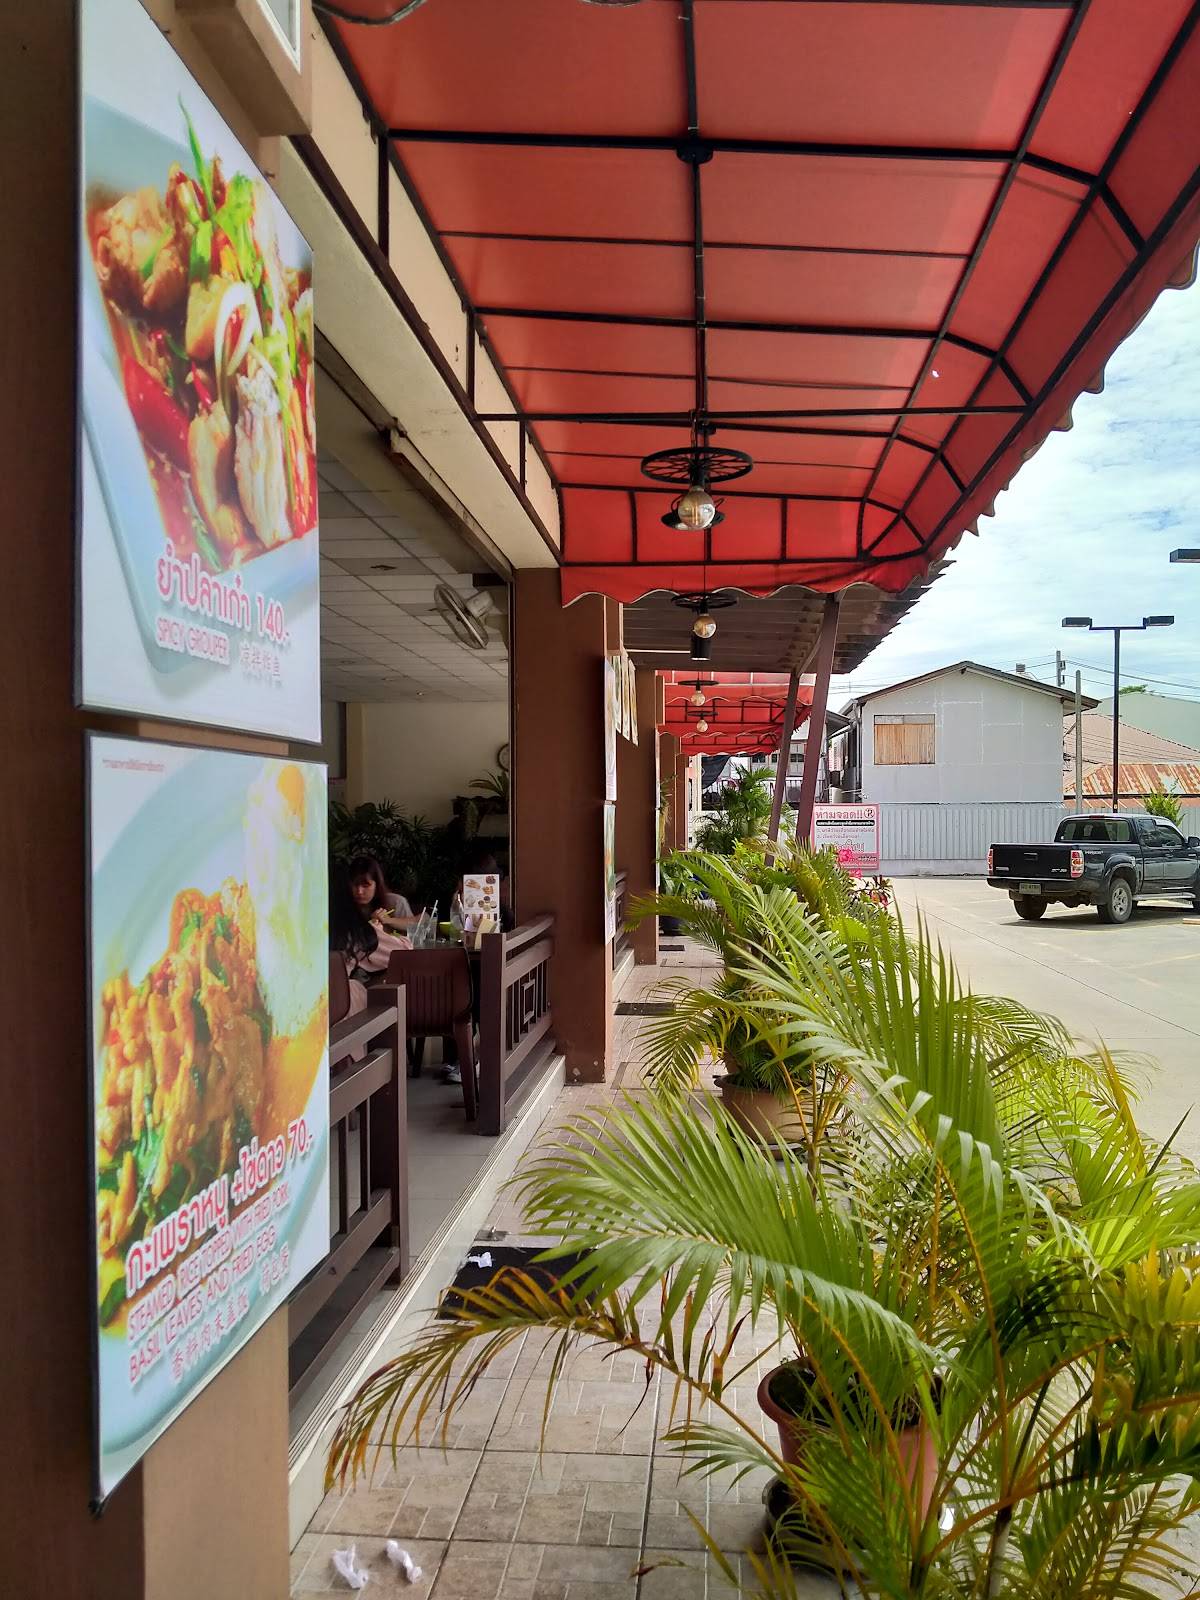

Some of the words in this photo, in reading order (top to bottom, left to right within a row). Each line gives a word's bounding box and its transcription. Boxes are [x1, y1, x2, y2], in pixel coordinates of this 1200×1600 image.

[157, 541, 251, 627] ยำปลาเก๋า
[157, 616, 186, 649] SPICY
[187, 625, 230, 661] GROUPER
[128, 1178, 228, 1293] กะเพราหมู
[129, 1279, 174, 1341] STEAMED
[179, 1255, 199, 1292] RICE
[200, 1230, 232, 1272] TOPPED
[130, 1332, 161, 1383] BASIL
[165, 1289, 202, 1344] LEAVES
[207, 1266, 230, 1299] AND
[232, 1243, 254, 1275] FRIED
[256, 1224, 278, 1257] EGG
